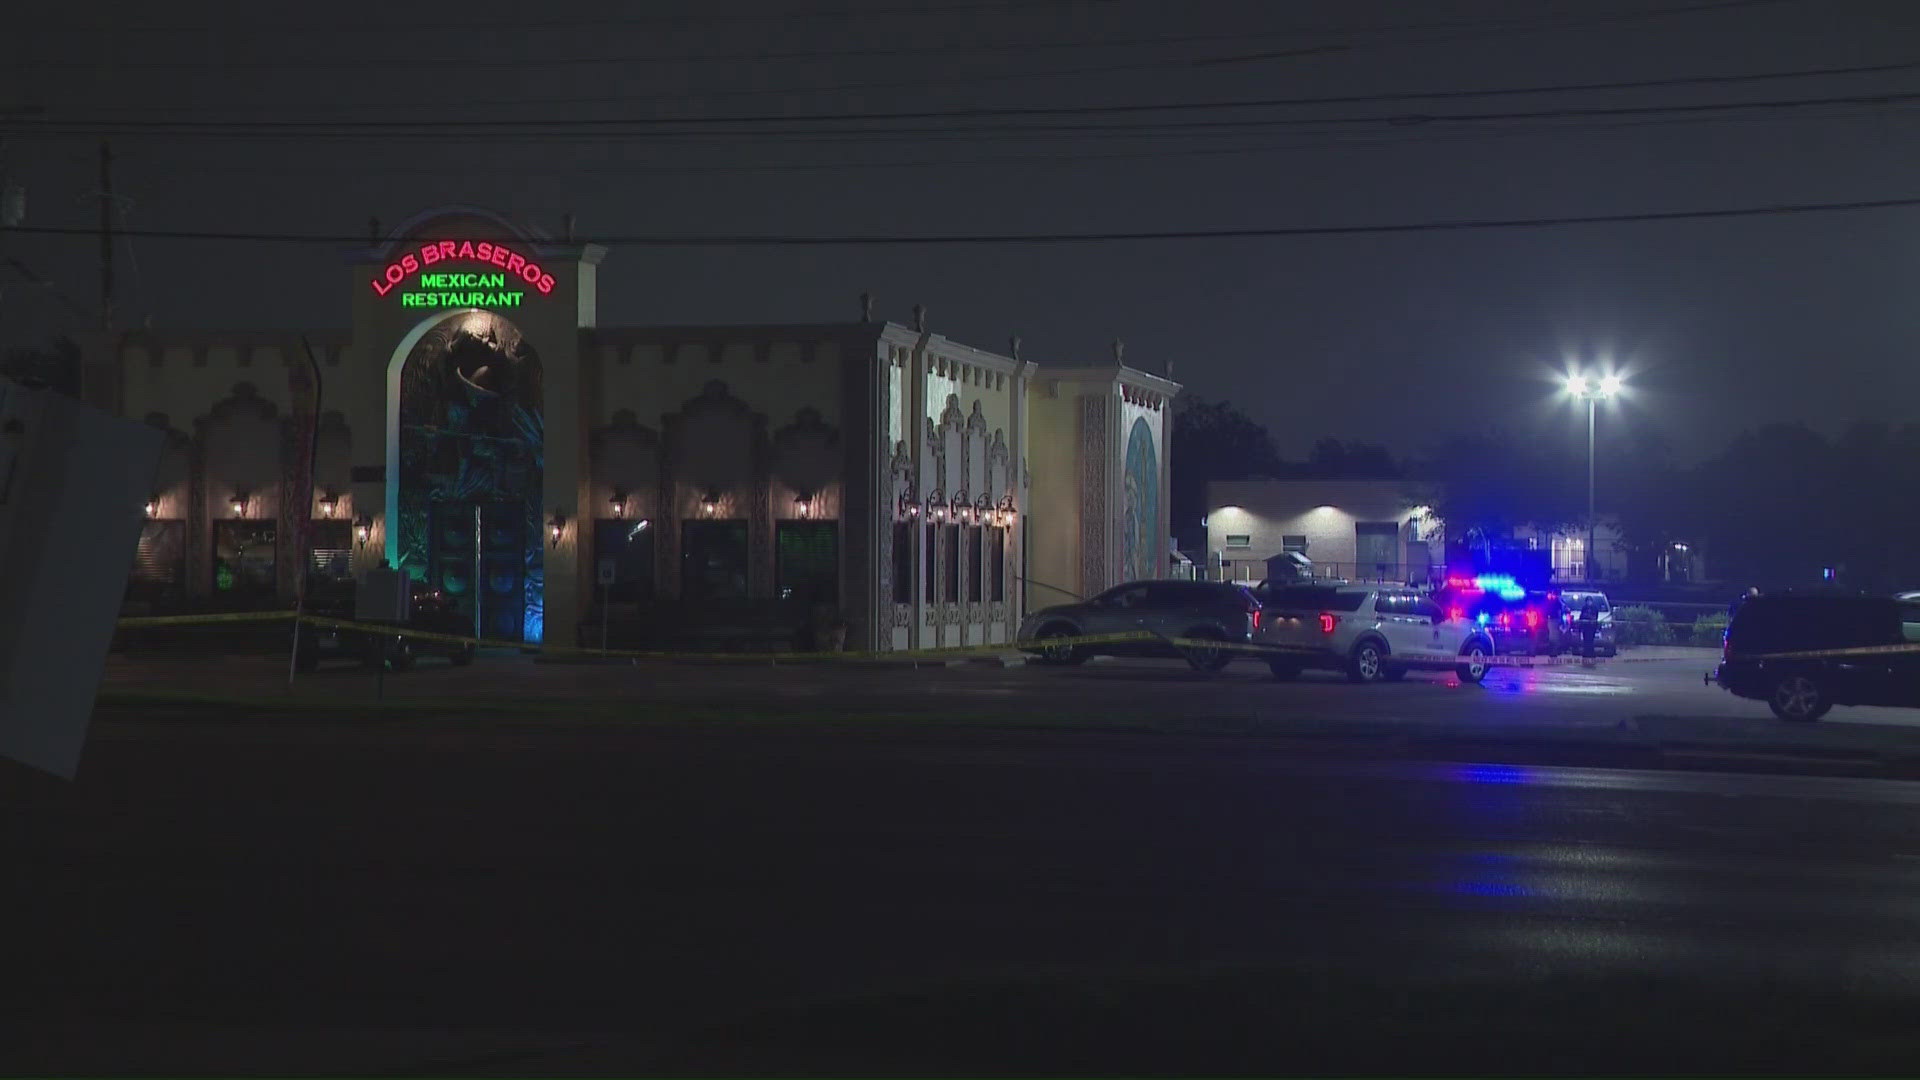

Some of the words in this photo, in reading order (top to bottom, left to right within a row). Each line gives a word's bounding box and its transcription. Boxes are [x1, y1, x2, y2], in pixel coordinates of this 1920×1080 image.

[373, 255, 419, 296] LOS
[421, 241, 555, 293] BRASEROS
[421, 274, 504, 288] MEXICAN
[402, 292, 523, 306] RESTAURANT
